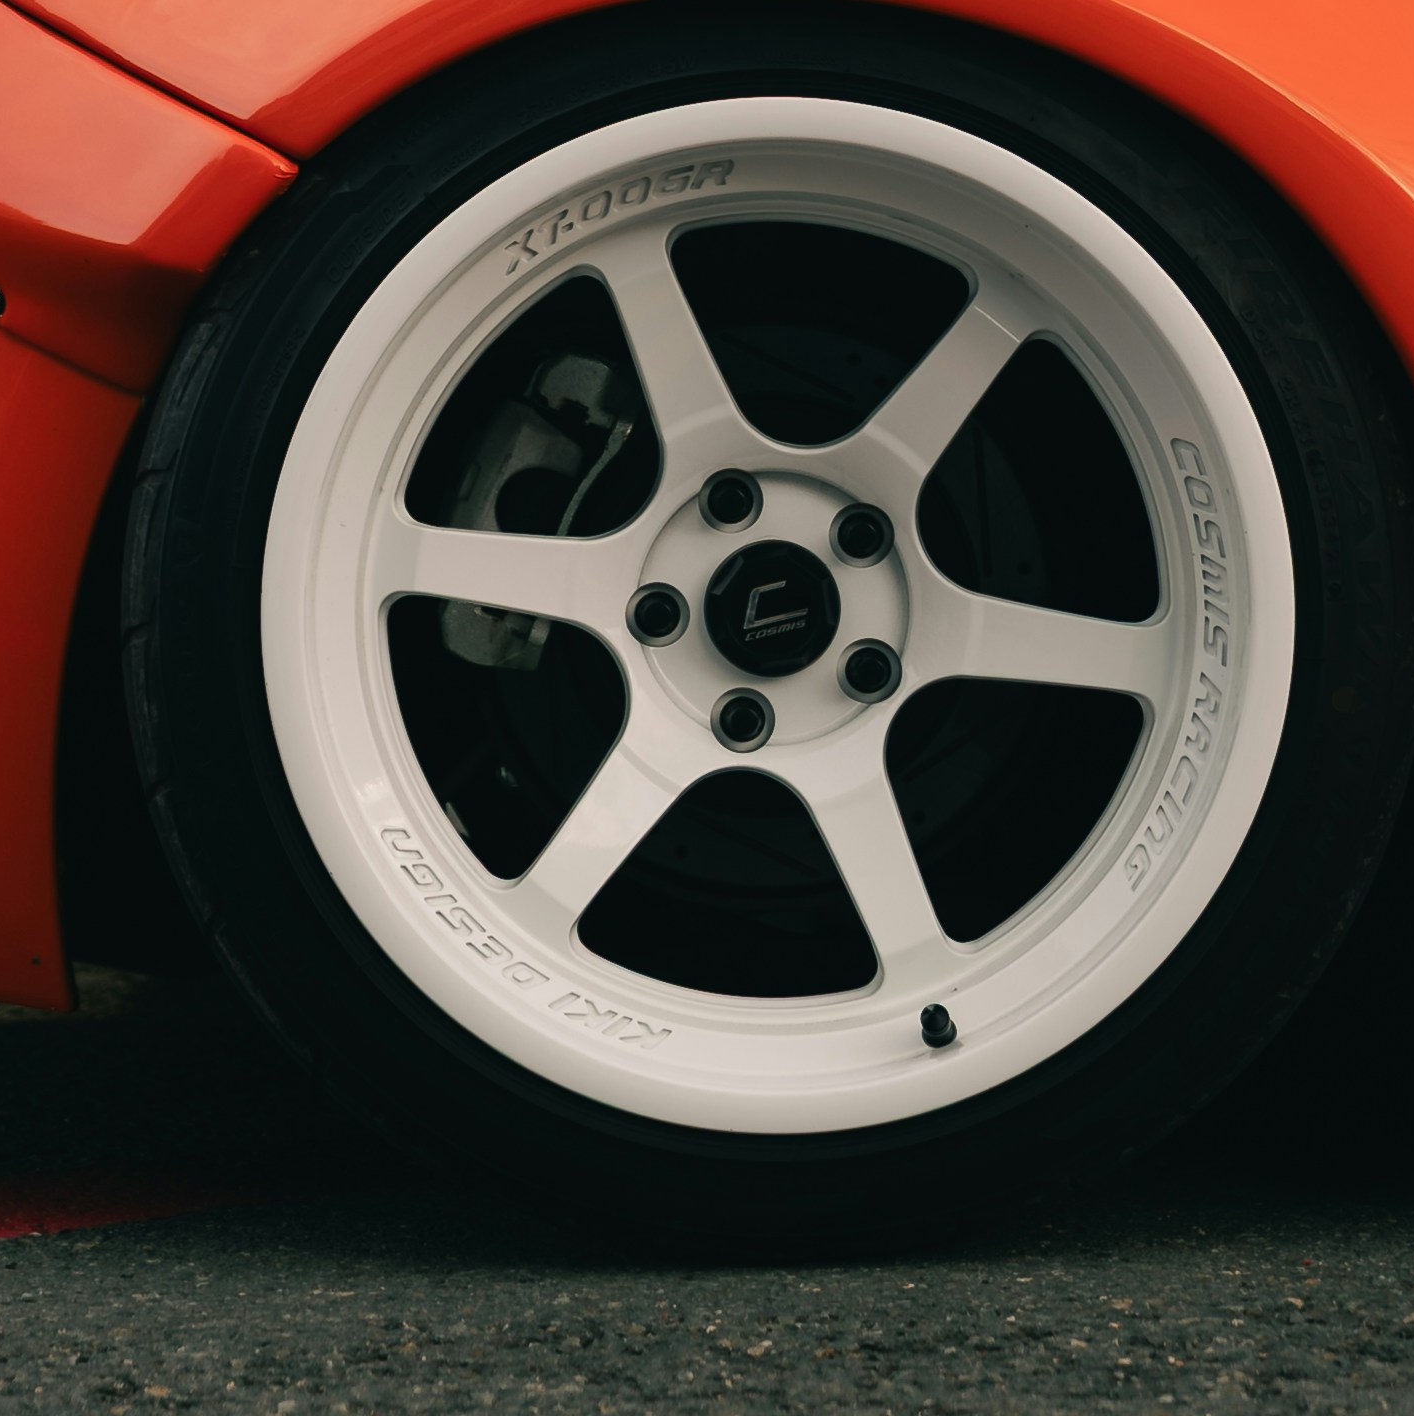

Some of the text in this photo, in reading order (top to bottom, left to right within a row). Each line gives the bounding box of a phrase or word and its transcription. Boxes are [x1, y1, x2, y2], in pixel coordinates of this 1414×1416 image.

[744, 619, 807, 642] COSMIS
[1124, 437, 1231, 891] COSMIS RACING
[380, 827, 672, 1050] KIKI DESIGN
